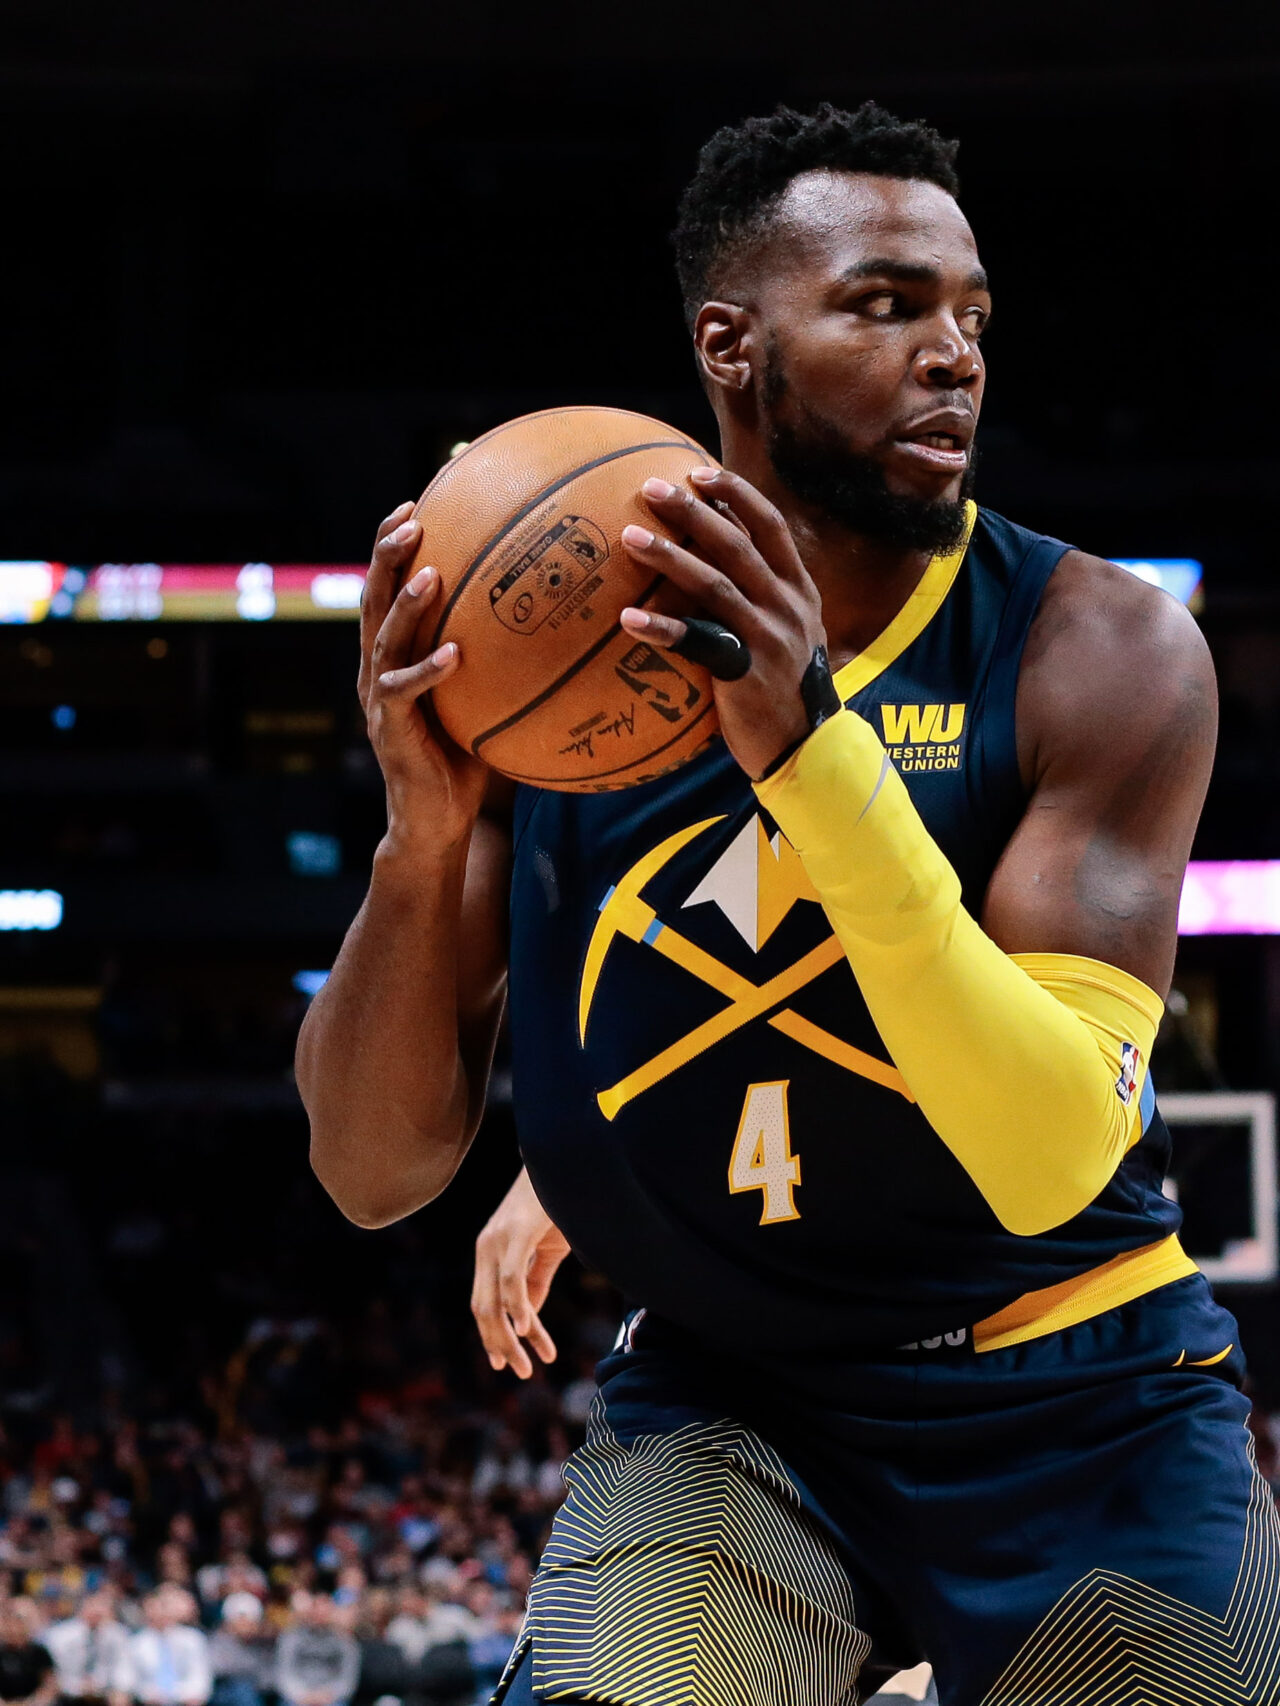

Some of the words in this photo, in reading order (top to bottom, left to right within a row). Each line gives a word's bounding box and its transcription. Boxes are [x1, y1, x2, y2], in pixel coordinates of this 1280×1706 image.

[624, 647, 652, 669] NBA
[881, 704, 966, 744] WU
[901, 757, 959, 771] UNION
[728, 1079, 801, 1226] 4
